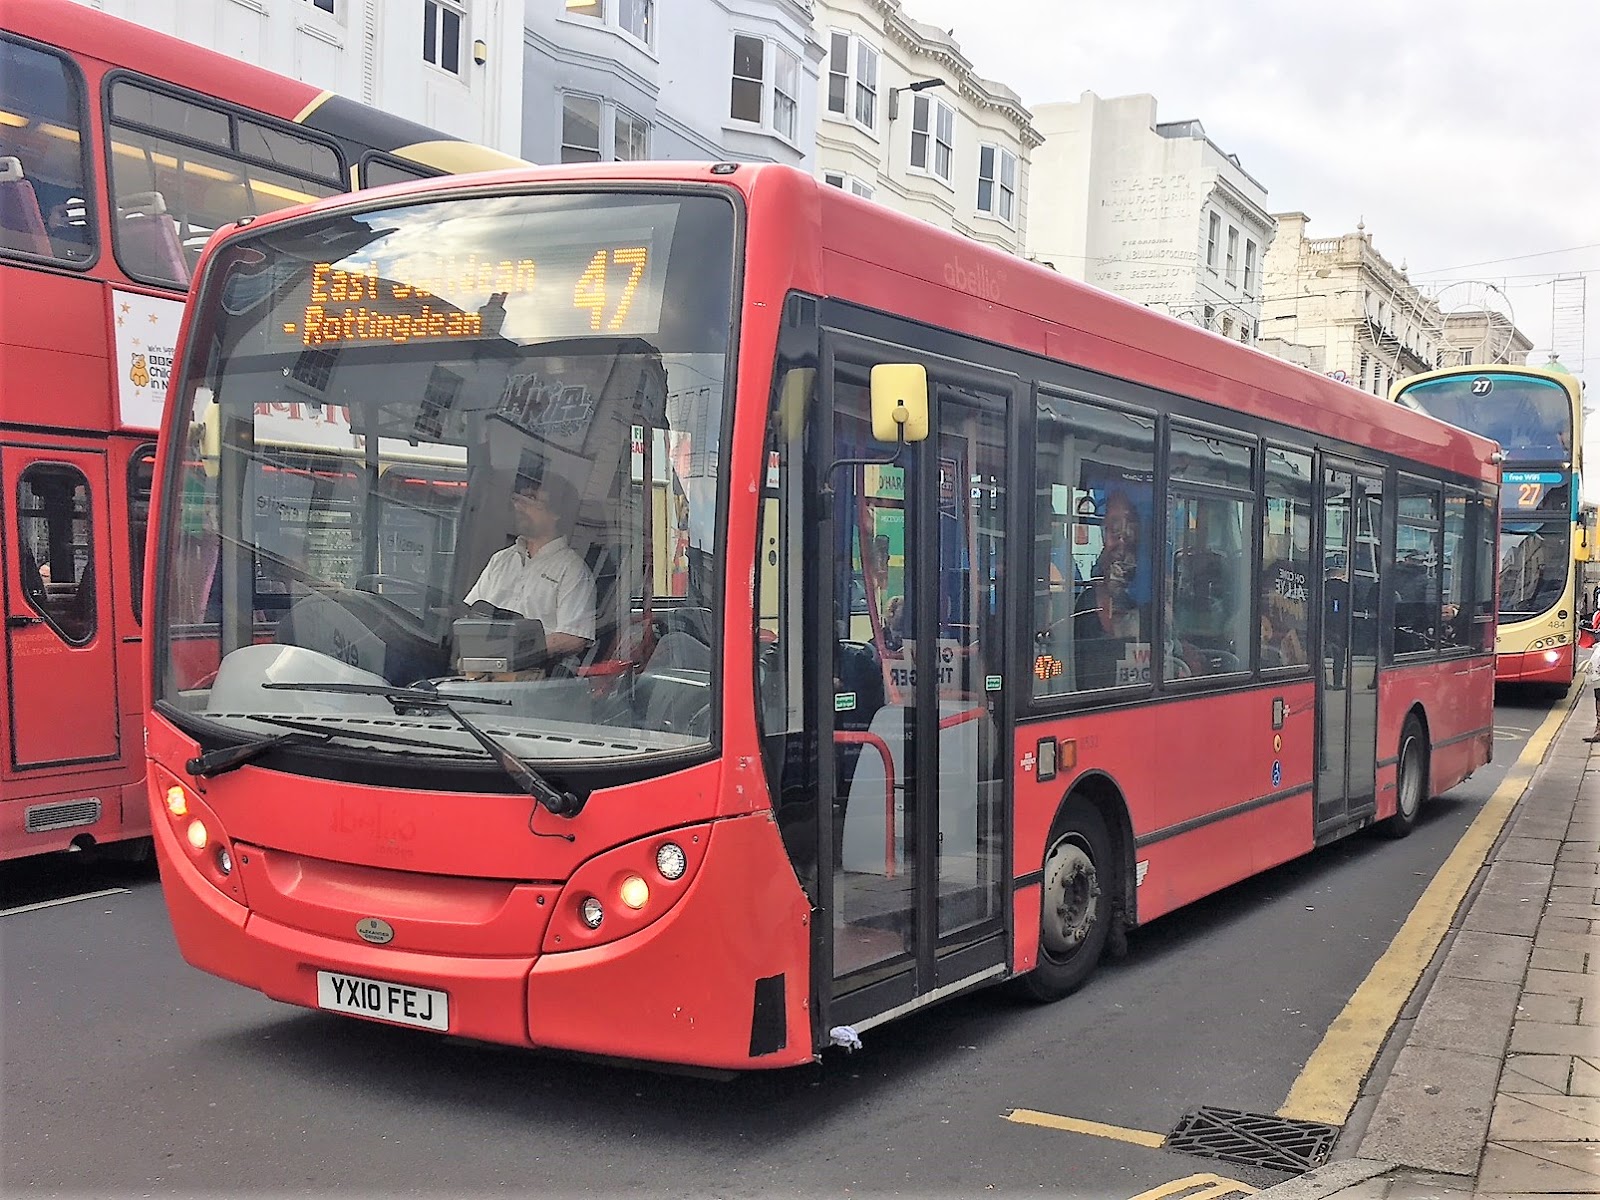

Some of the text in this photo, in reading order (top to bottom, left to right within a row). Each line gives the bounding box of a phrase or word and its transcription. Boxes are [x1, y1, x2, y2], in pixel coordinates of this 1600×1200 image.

[311, 261, 378, 301] East
[573, 246, 648, 330] 47
[303, 304, 483, 345] Rottingdean
[1472, 380, 1490, 393] 27
[1508, 473, 1523, 481] free
[1518, 484, 1541, 506] 27
[1548, 620, 1565, 629] 484
[331, 976, 433, 1021] YX10 FEJ
